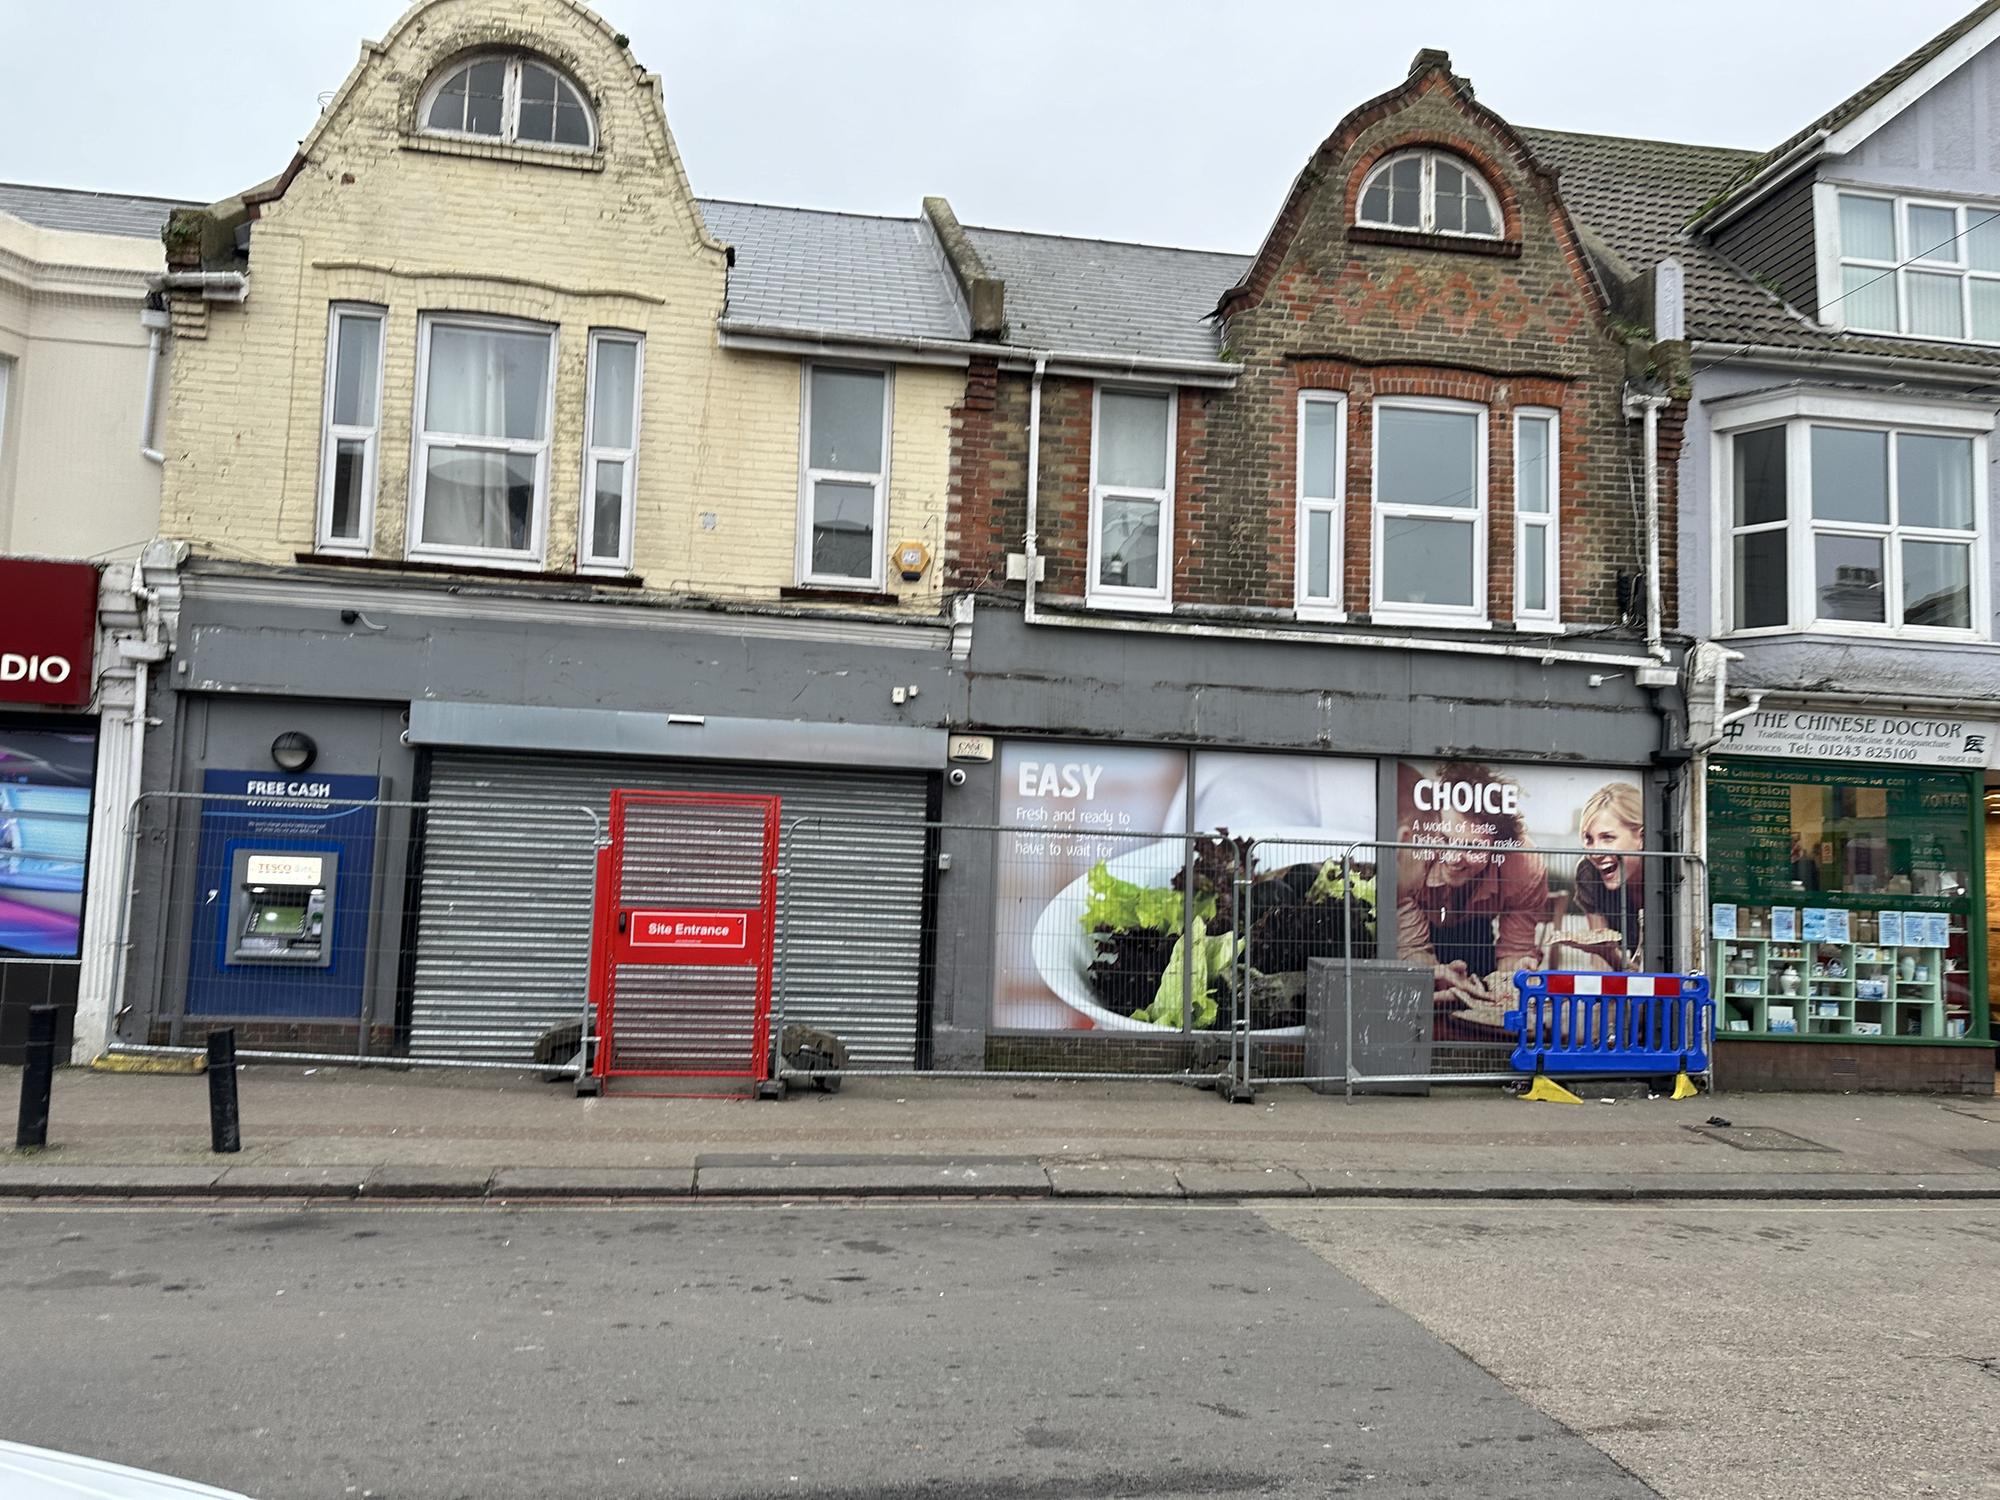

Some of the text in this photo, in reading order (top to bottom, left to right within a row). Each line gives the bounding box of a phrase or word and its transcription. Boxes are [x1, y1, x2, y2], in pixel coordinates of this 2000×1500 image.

[0, 653, 71, 684] DIO
[1752, 712, 1962, 738] THE CHINESE DOCTOR
[1758, 730, 1804, 740] Traditional
[1806, 732, 1841, 741] Chinese
[1845, 734, 1882, 744] Medicine
[1895, 738, 1951, 749] Acupuncture
[1818, 743, 1860, 757] 01243
[1865, 746, 1917, 760] 825100
[247, 780, 330, 797] FREE CASH
[1019, 761, 1103, 800] EASY
[1413, 779, 1520, 815] CHOICE
[1016, 807, 1130, 826] Fresh and ready to
[1412, 820, 1420, 831] A
[1423, 820, 1452, 833] world
[1455, 821, 1467, 834] of
[1015, 840, 1114, 857] have to wait for
[1449, 837, 1468, 848] you
[1471, 839, 1491, 848] can
[1493, 837, 1522, 848] make
[1412, 848, 1506, 868] with your feet up
[258, 863, 292, 874] TESCO
[648, 922, 729, 936] Site Entrance
